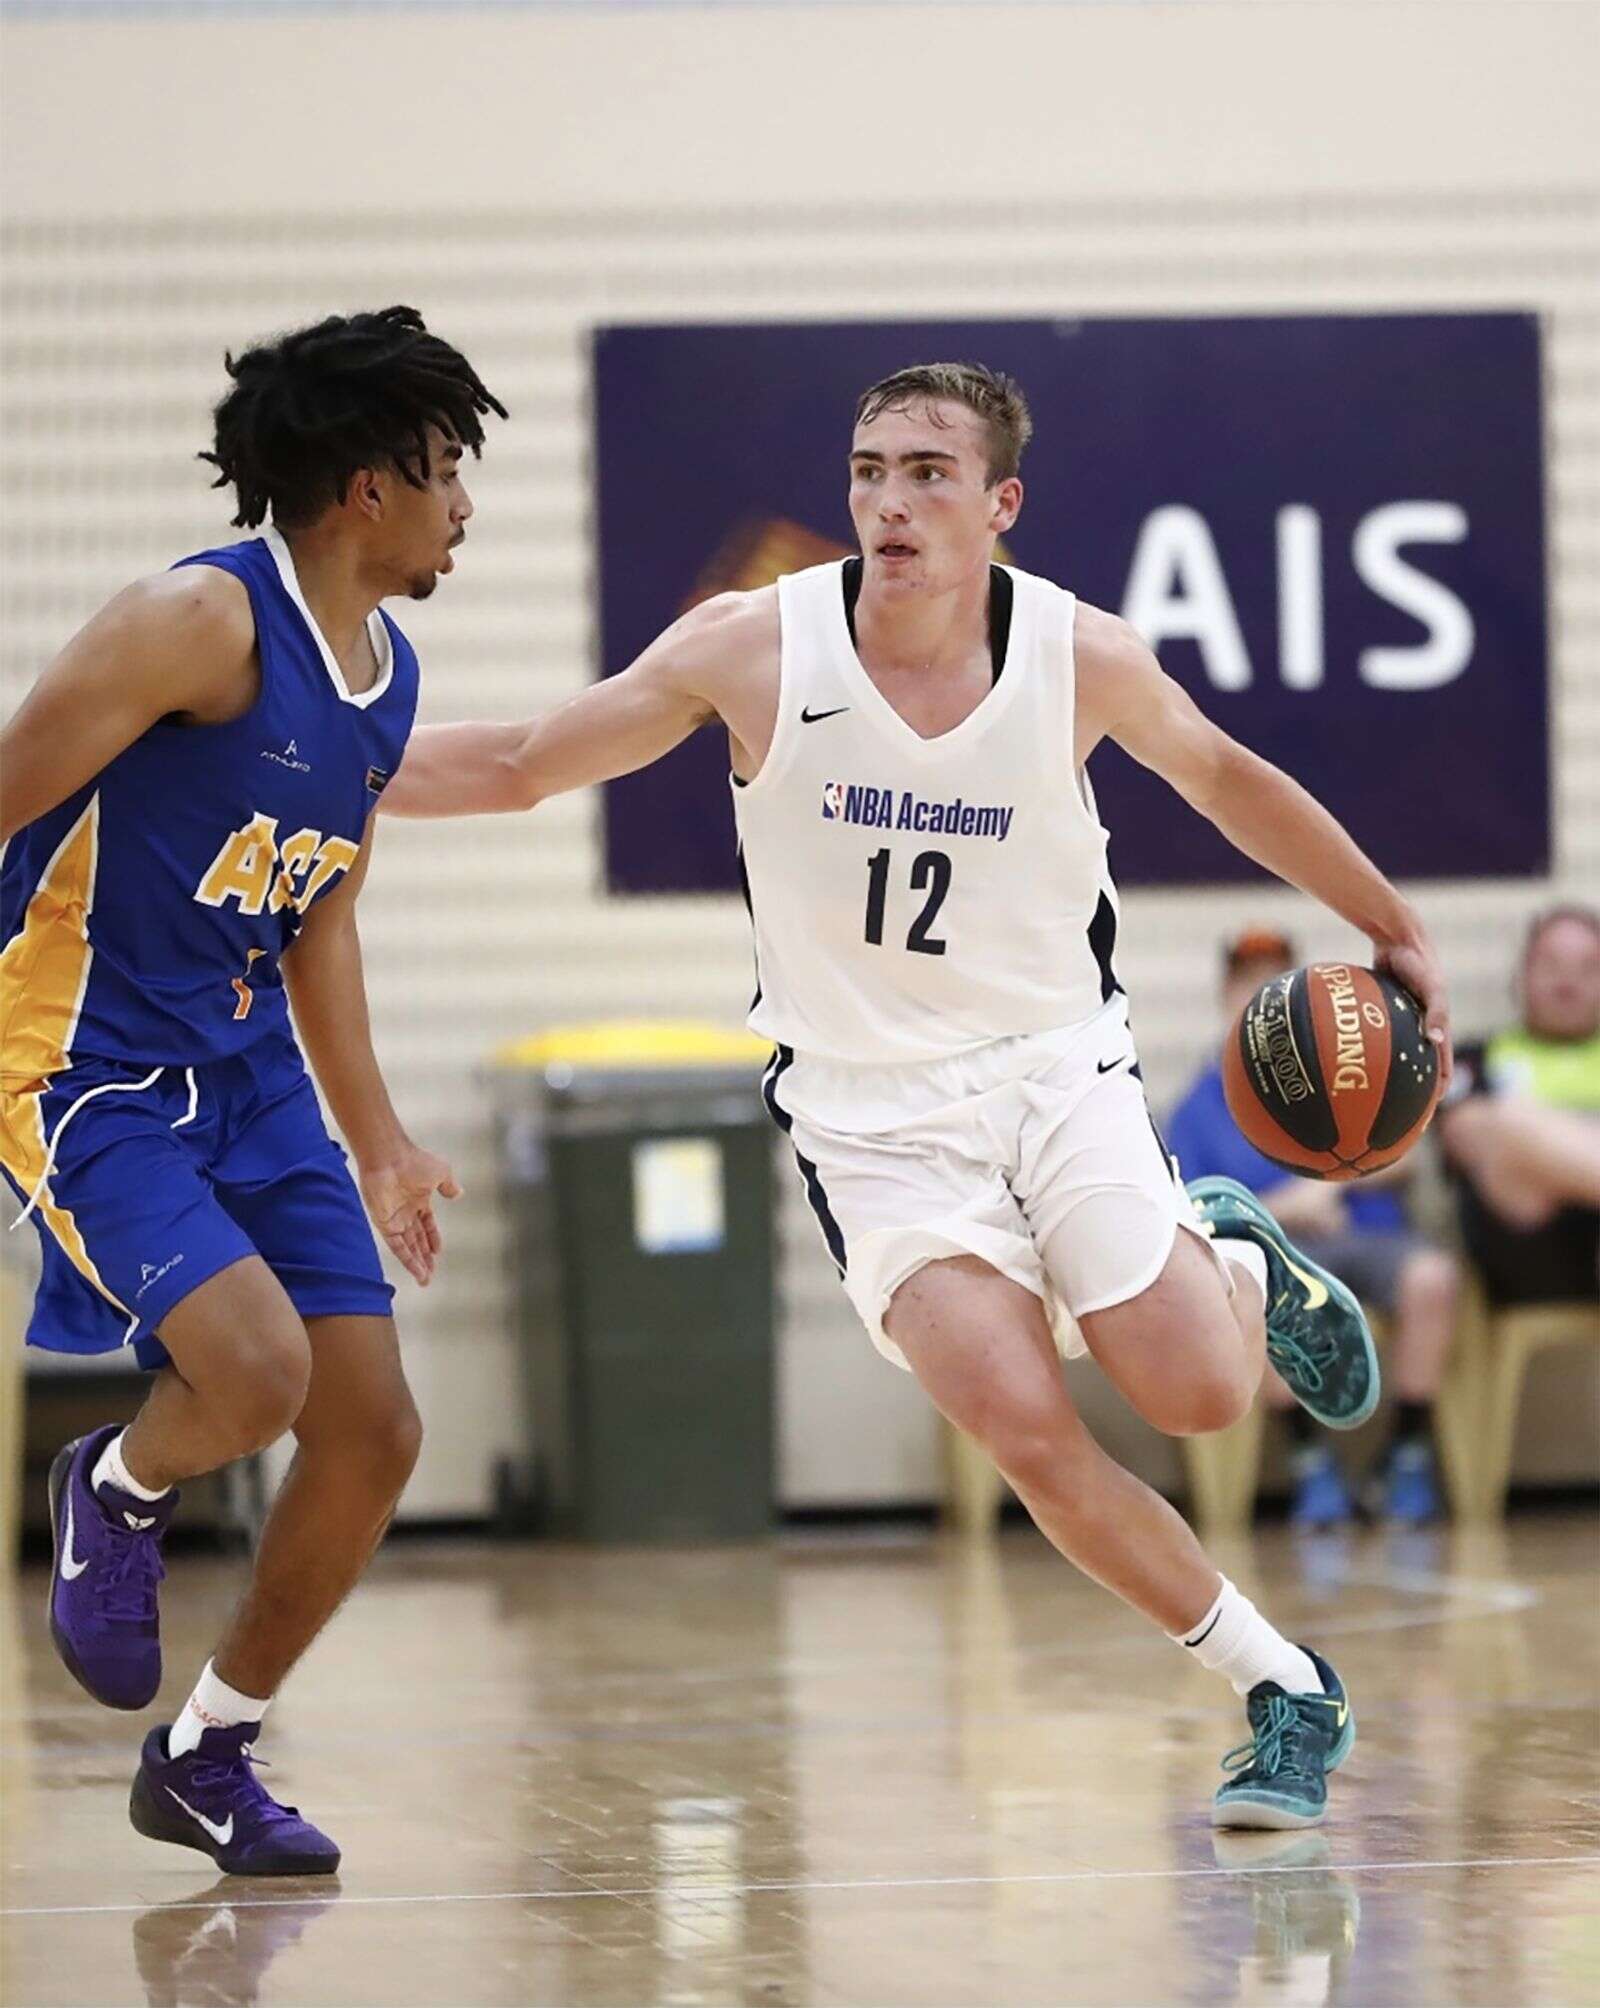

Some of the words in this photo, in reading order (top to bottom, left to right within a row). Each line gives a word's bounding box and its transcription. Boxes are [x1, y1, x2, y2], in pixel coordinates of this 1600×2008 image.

[1122, 501, 1476, 692] AIS
[844, 785, 893, 828] NBA
[896, 792, 1014, 842] Academy
[865, 848, 952, 956] 12
[1314, 964, 1368, 1091] SPALDING
